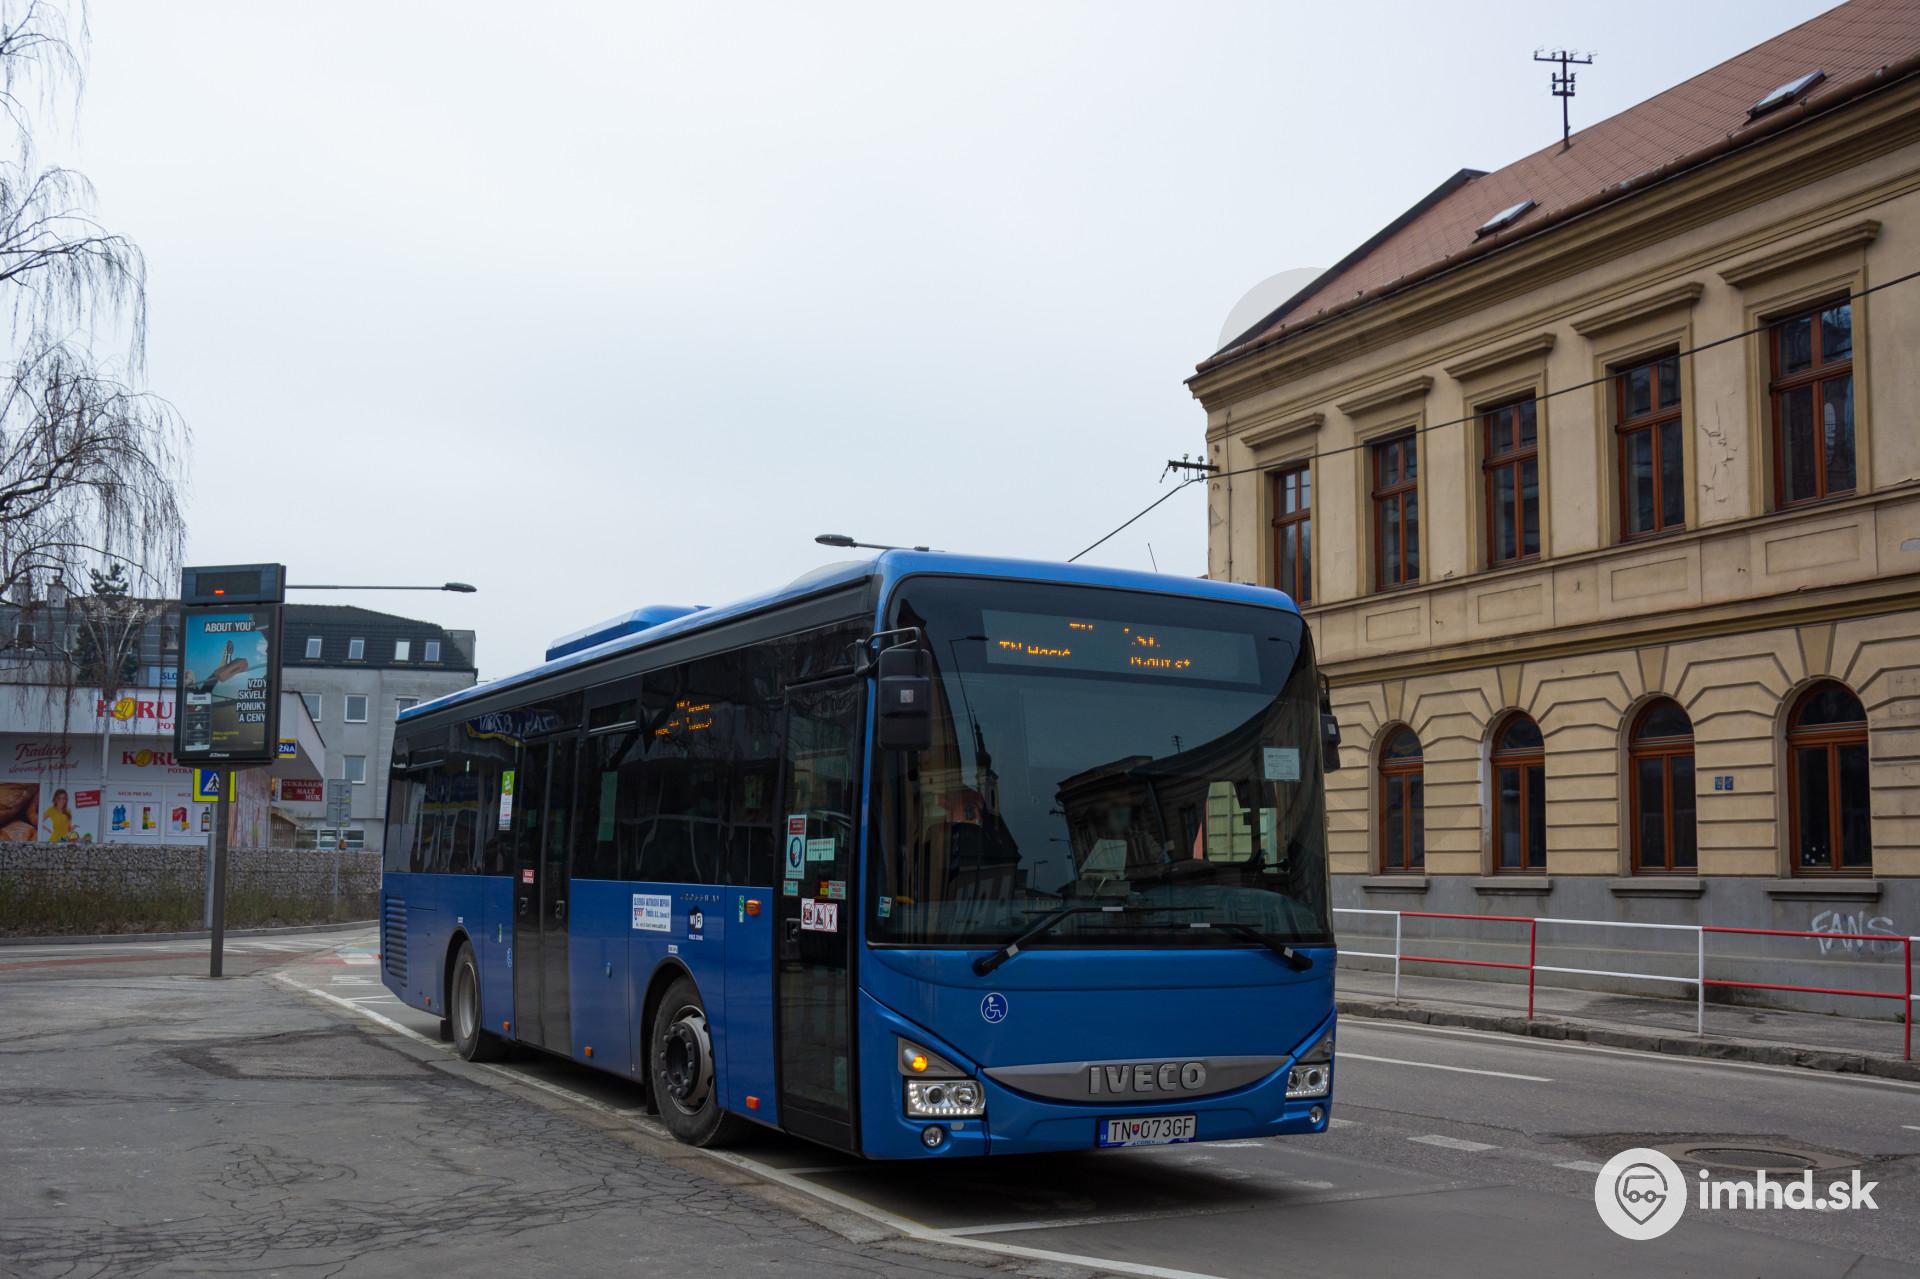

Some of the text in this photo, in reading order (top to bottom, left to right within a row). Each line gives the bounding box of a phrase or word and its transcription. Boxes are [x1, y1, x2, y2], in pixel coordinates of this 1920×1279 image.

[205, 622, 232, 632] ABOUT
[237, 702, 265, 711] PONUKY
[240, 714, 265, 722] A CENY
[1805, 910, 1901, 955] FANS
[1089, 1062, 1206, 1094] IVECO
